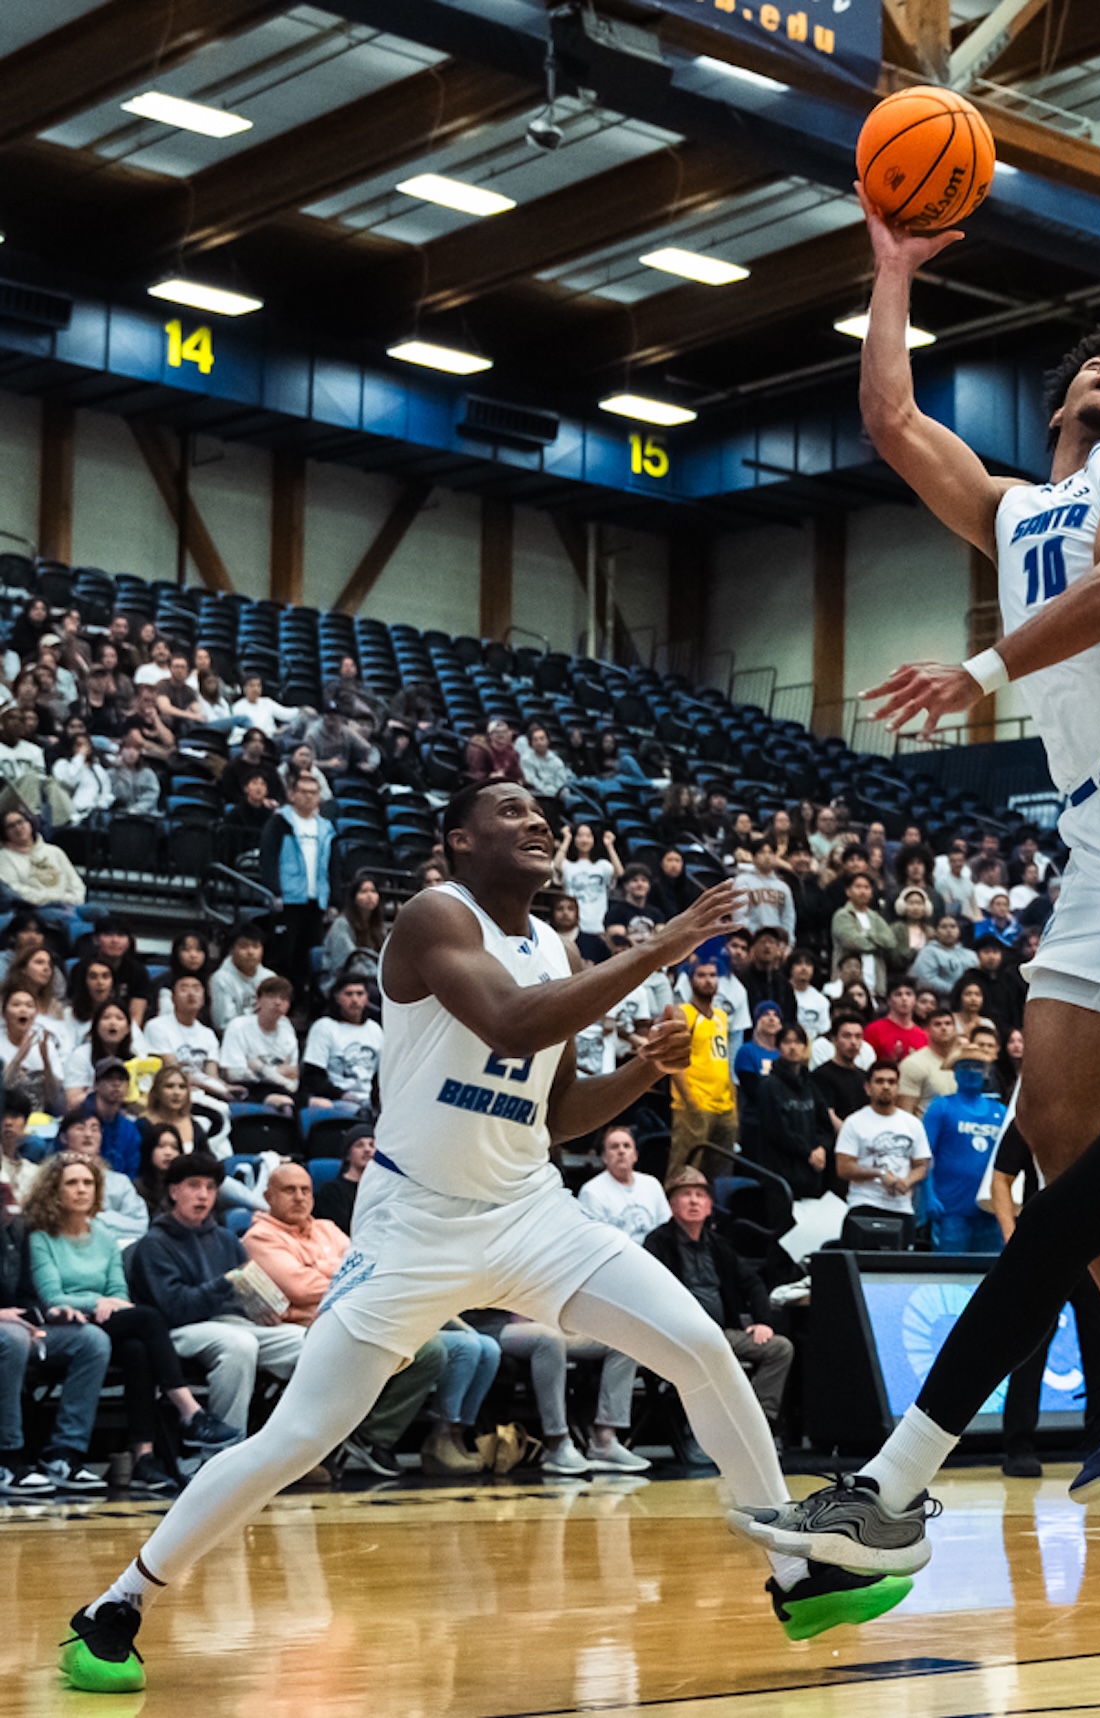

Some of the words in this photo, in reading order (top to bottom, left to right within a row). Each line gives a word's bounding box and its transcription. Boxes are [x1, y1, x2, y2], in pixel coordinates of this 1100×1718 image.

[165, 319, 215, 374] 14
[629, 433, 669, 478] 15
[1010, 503, 1092, 546] SANTA
[1023, 534, 1068, 606] 10
